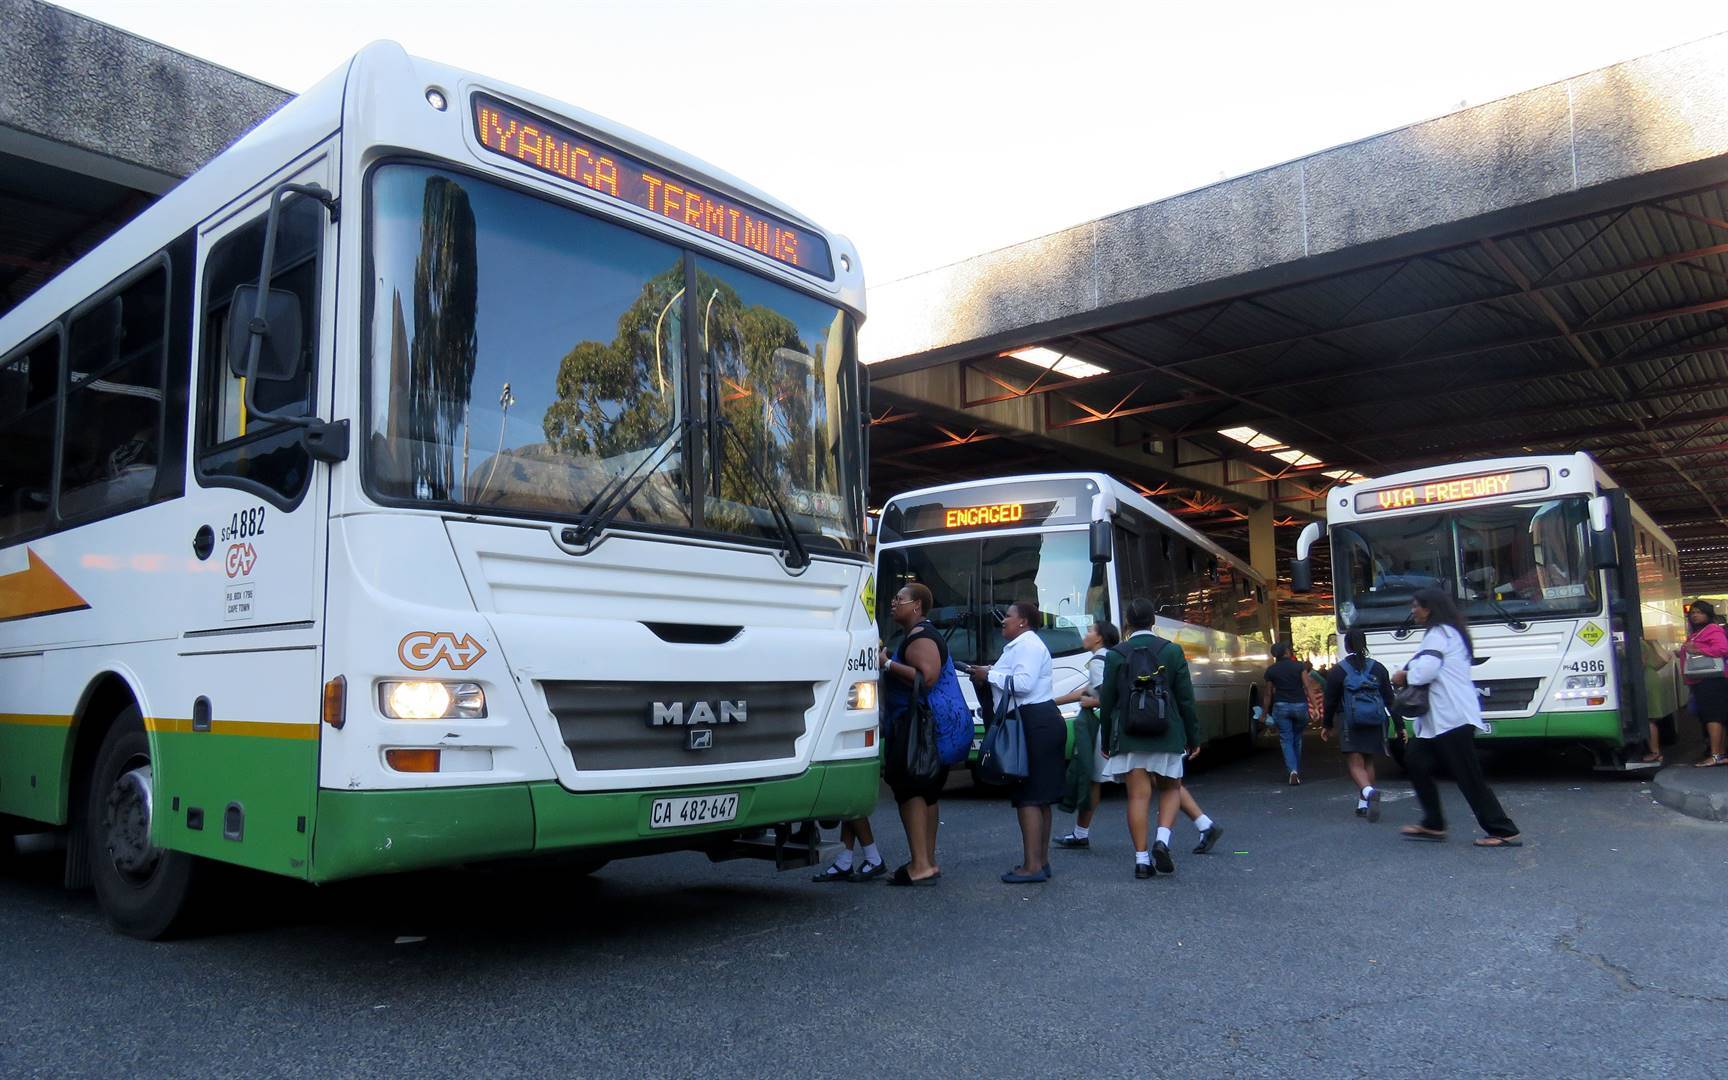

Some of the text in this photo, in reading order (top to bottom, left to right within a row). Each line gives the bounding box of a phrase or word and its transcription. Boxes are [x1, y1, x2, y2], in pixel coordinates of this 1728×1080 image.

[1379, 474, 1510, 508] VIA FREEWAY
[946, 503, 1023, 527] ENGAGED
[652, 700, 747, 725] MAN
[653, 802, 672, 823] CA
